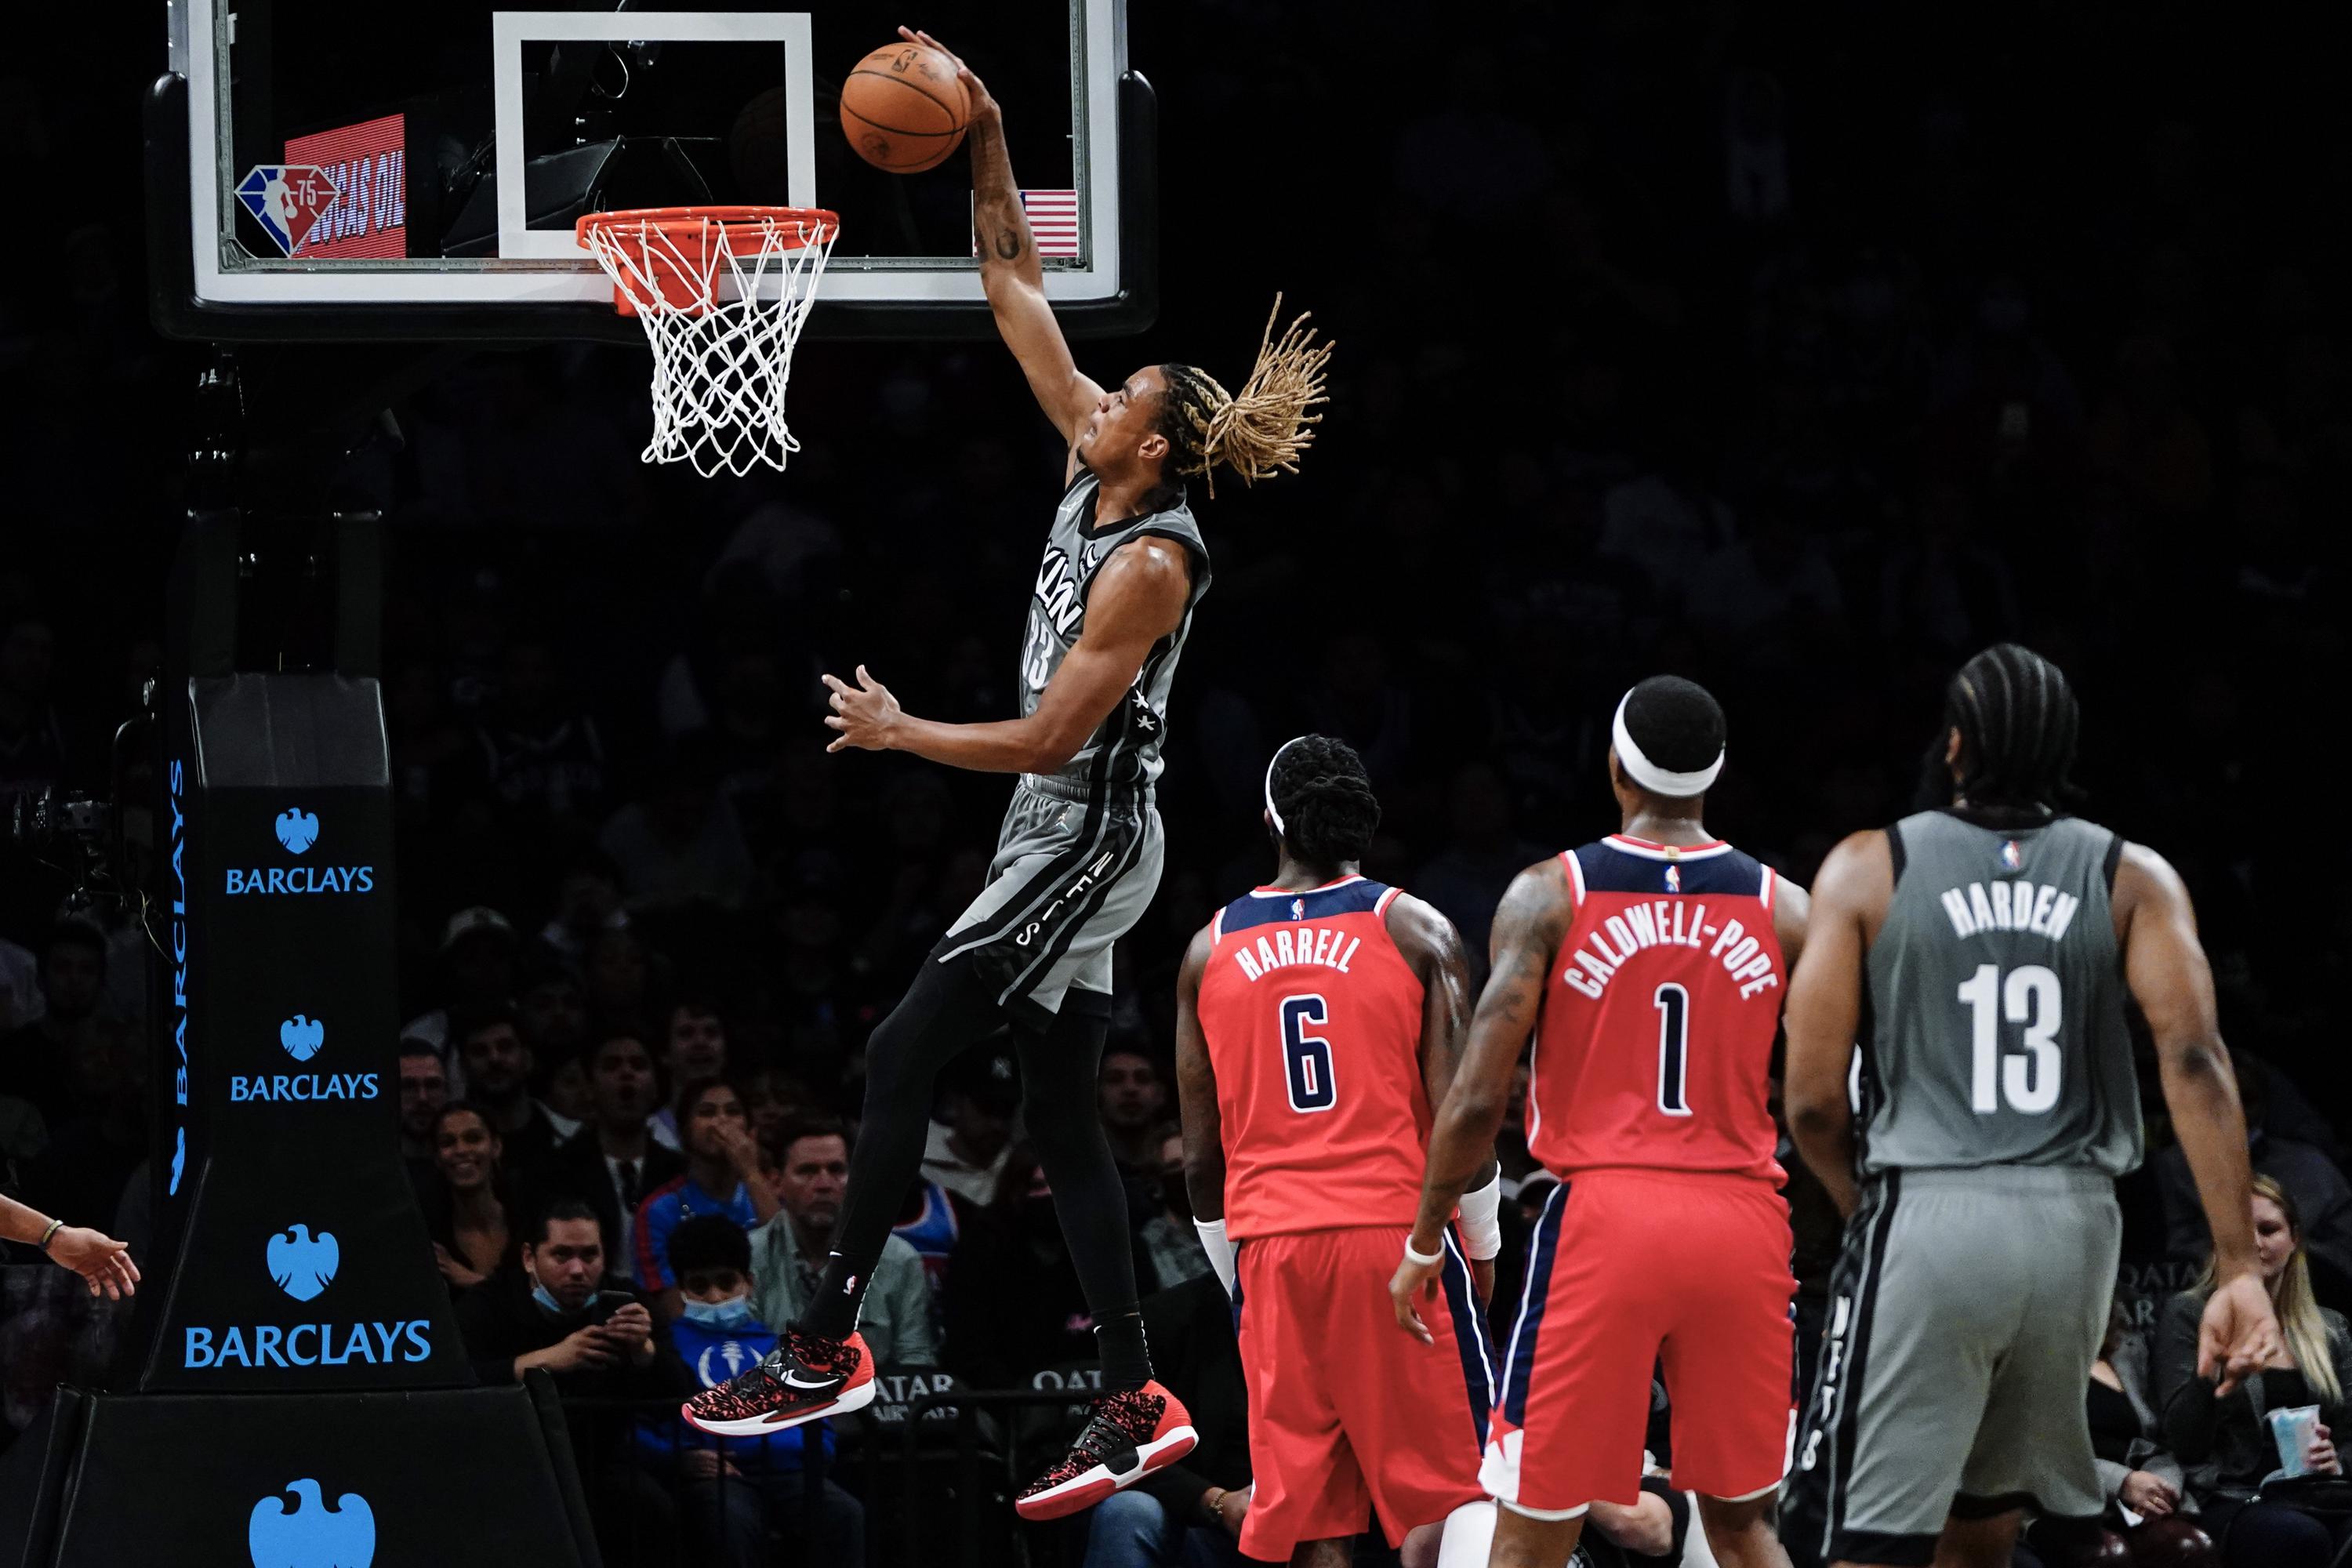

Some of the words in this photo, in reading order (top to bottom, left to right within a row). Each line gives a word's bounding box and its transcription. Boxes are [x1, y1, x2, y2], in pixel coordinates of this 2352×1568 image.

[296, 180, 317, 205] 75
[374, 150, 404, 231] OIL
[226, 866, 373, 894] BARCLAYS
[1940, 880, 2080, 942] HARDEN
[171, 759, 188, 1106] BARCLAYS
[1235, 927, 1360, 982] HARRELL
[1564, 901, 1778, 1000] CALDWELL-POPE
[1279, 993, 1337, 1113] 6
[1654, 982, 1693, 1116] 1
[1958, 964, 2062, 1115] 13
[230, 1073, 379, 1101] BARCLAYS
[184, 1319, 432, 1368] BARCLAYS
